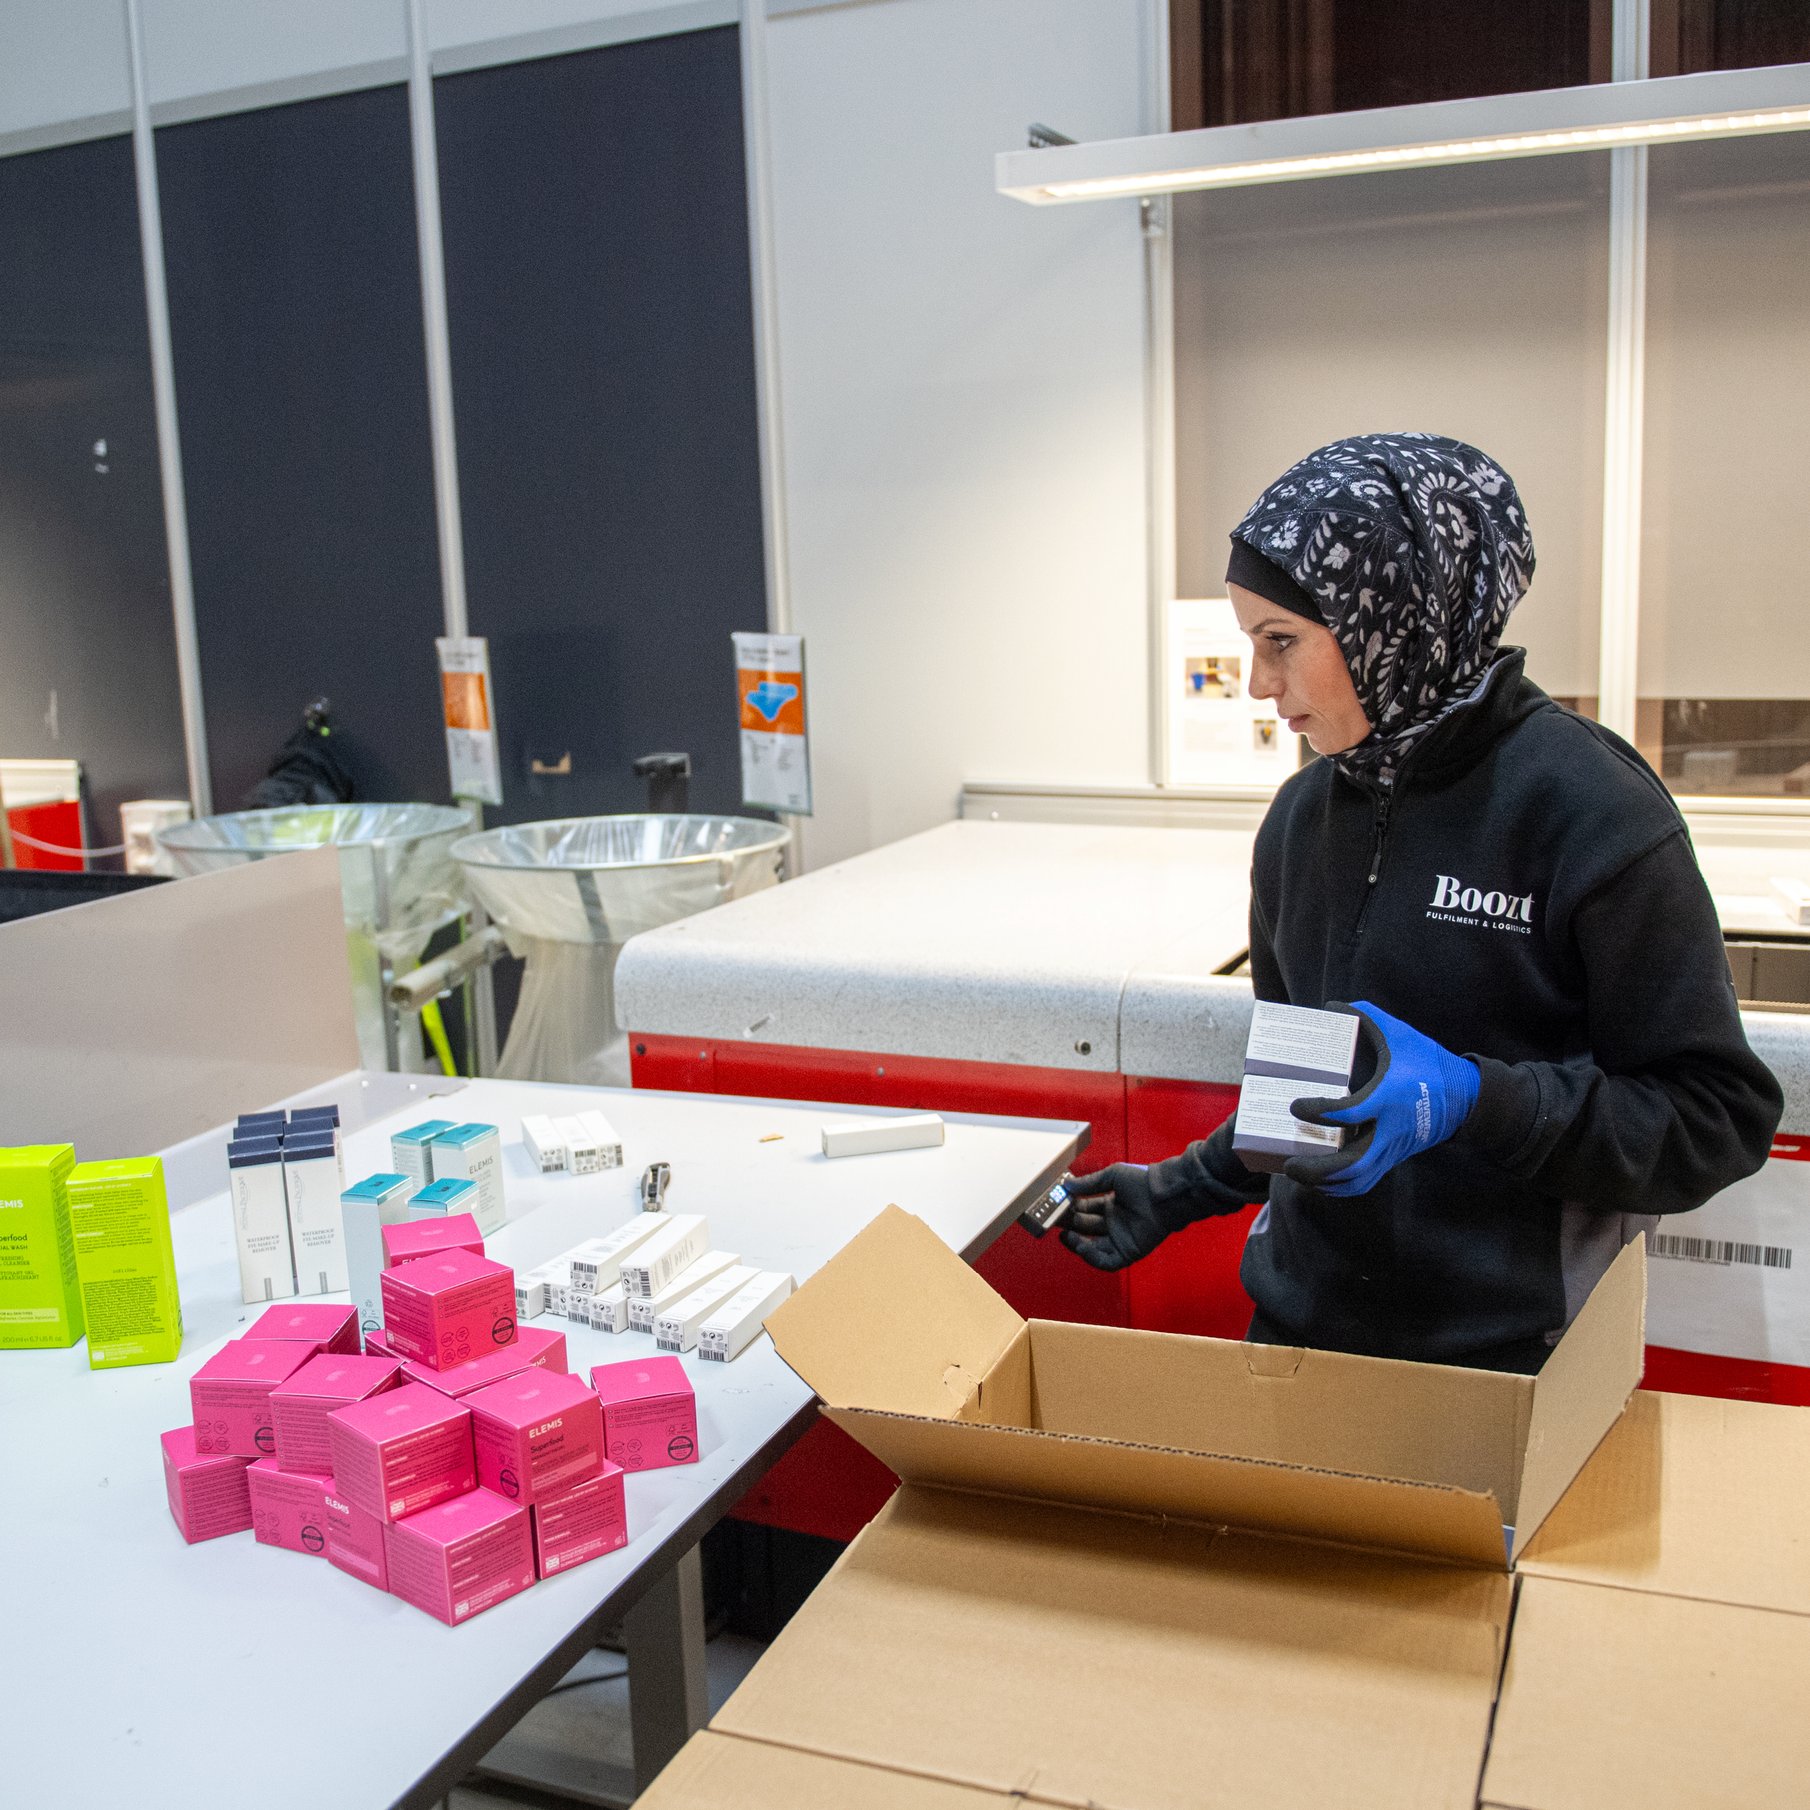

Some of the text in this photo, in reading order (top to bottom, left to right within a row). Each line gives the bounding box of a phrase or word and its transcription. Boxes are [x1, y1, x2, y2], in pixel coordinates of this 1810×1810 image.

[1429, 874, 1535, 923] Boozt
[1426, 911, 1479, 926] FULFILMENT
[1482, 920, 1488, 928] &
[469, 1155, 494, 1175] ELEMIS
[529, 1417, 563, 1439] ELEMIS
[325, 1496, 350, 1515] ELEMIS
